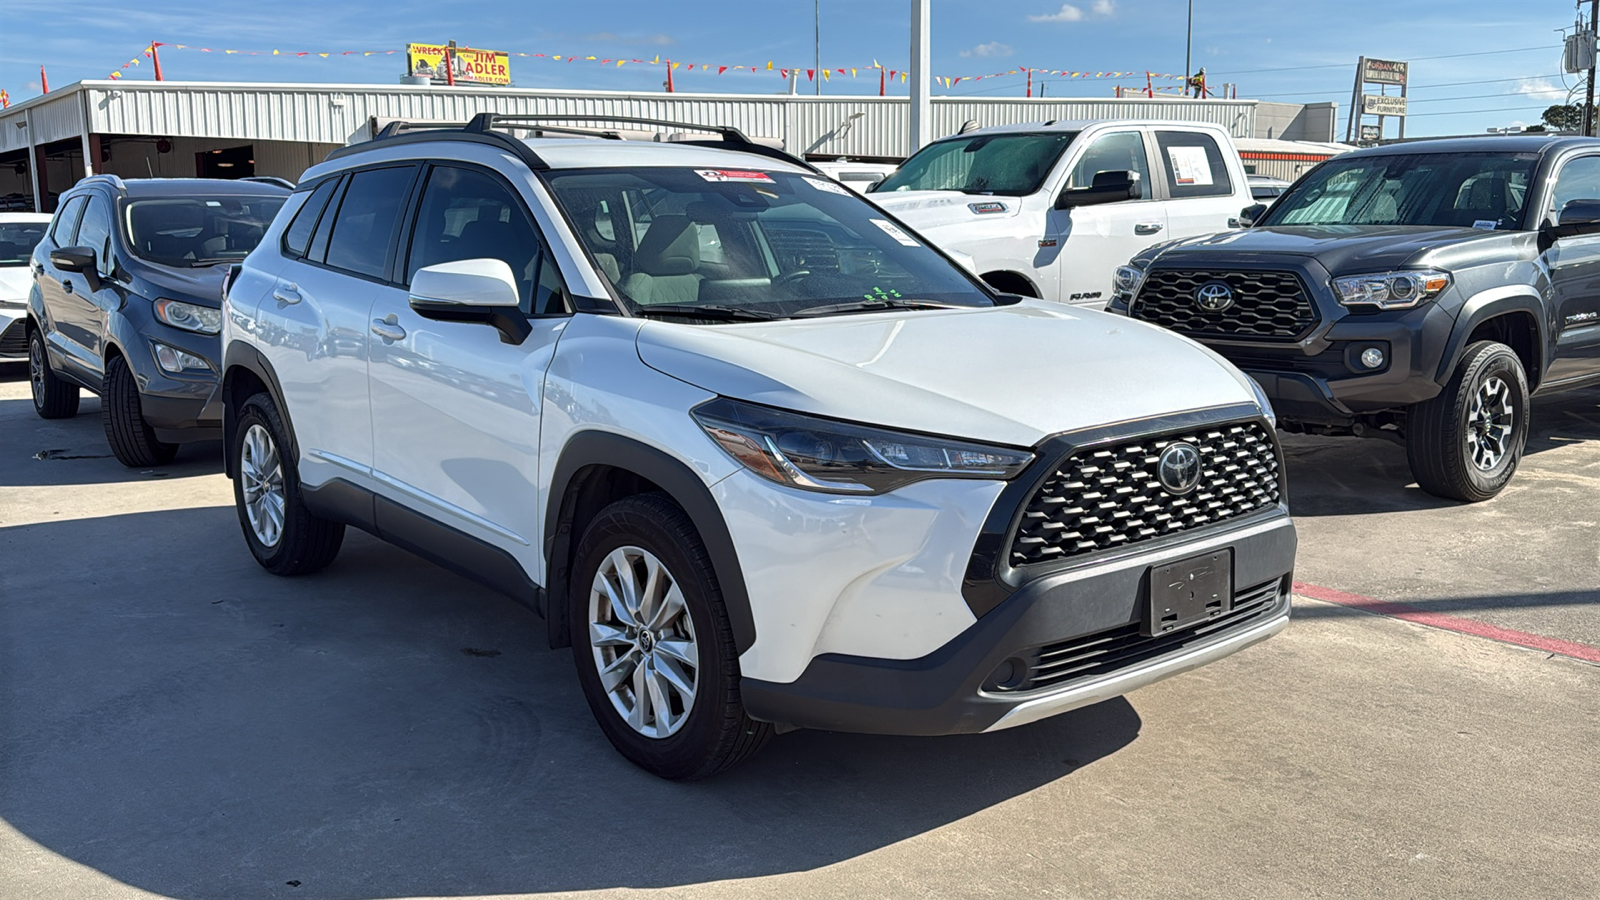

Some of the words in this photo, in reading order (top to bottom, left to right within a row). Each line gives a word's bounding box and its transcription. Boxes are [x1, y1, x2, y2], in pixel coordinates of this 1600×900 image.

[473, 51, 496, 64] JIM
[465, 61, 506, 76] ADLER
[1376, 97, 1406, 106] EXCLUSIVE
[1376, 105, 1406, 114] FURNITURE
[1070, 291, 1102, 300] RAM
